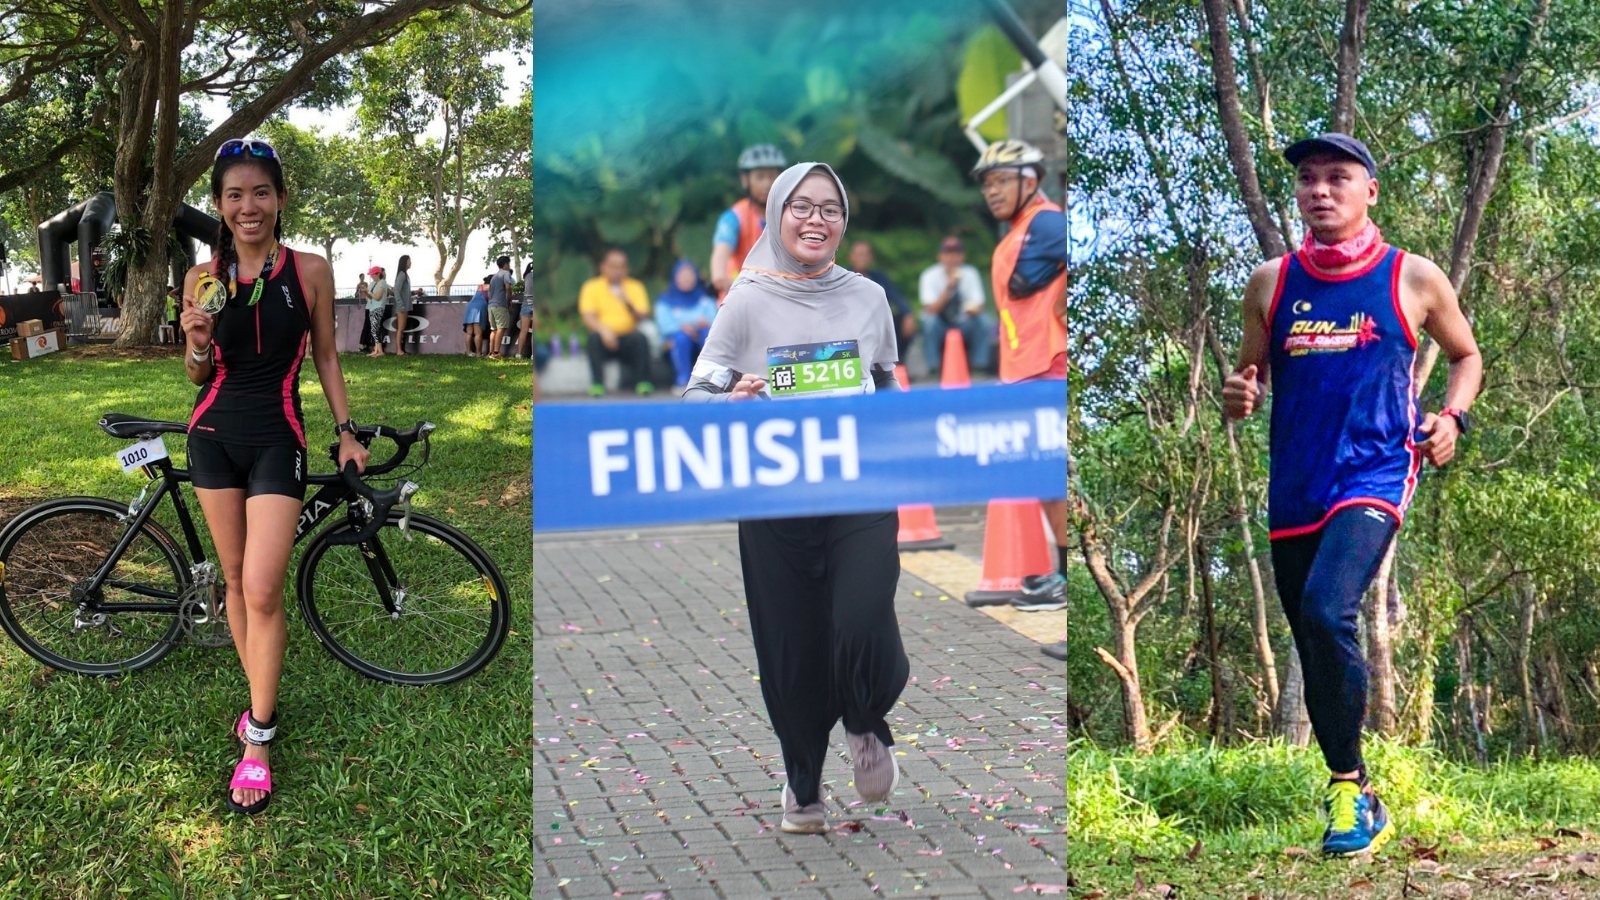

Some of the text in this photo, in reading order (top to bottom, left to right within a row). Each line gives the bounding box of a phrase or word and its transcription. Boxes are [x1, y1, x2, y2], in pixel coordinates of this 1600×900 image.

[281, 285, 294, 309] 2XU
[1290, 321, 1336, 334] RUN
[841, 351, 852, 359] 5K
[802, 360, 856, 384] 5216
[121, 447, 148, 467] 1010
[588, 414, 860, 497] FINISH
[936, 413, 1031, 466] Super
[295, 500, 332, 538] PIA
